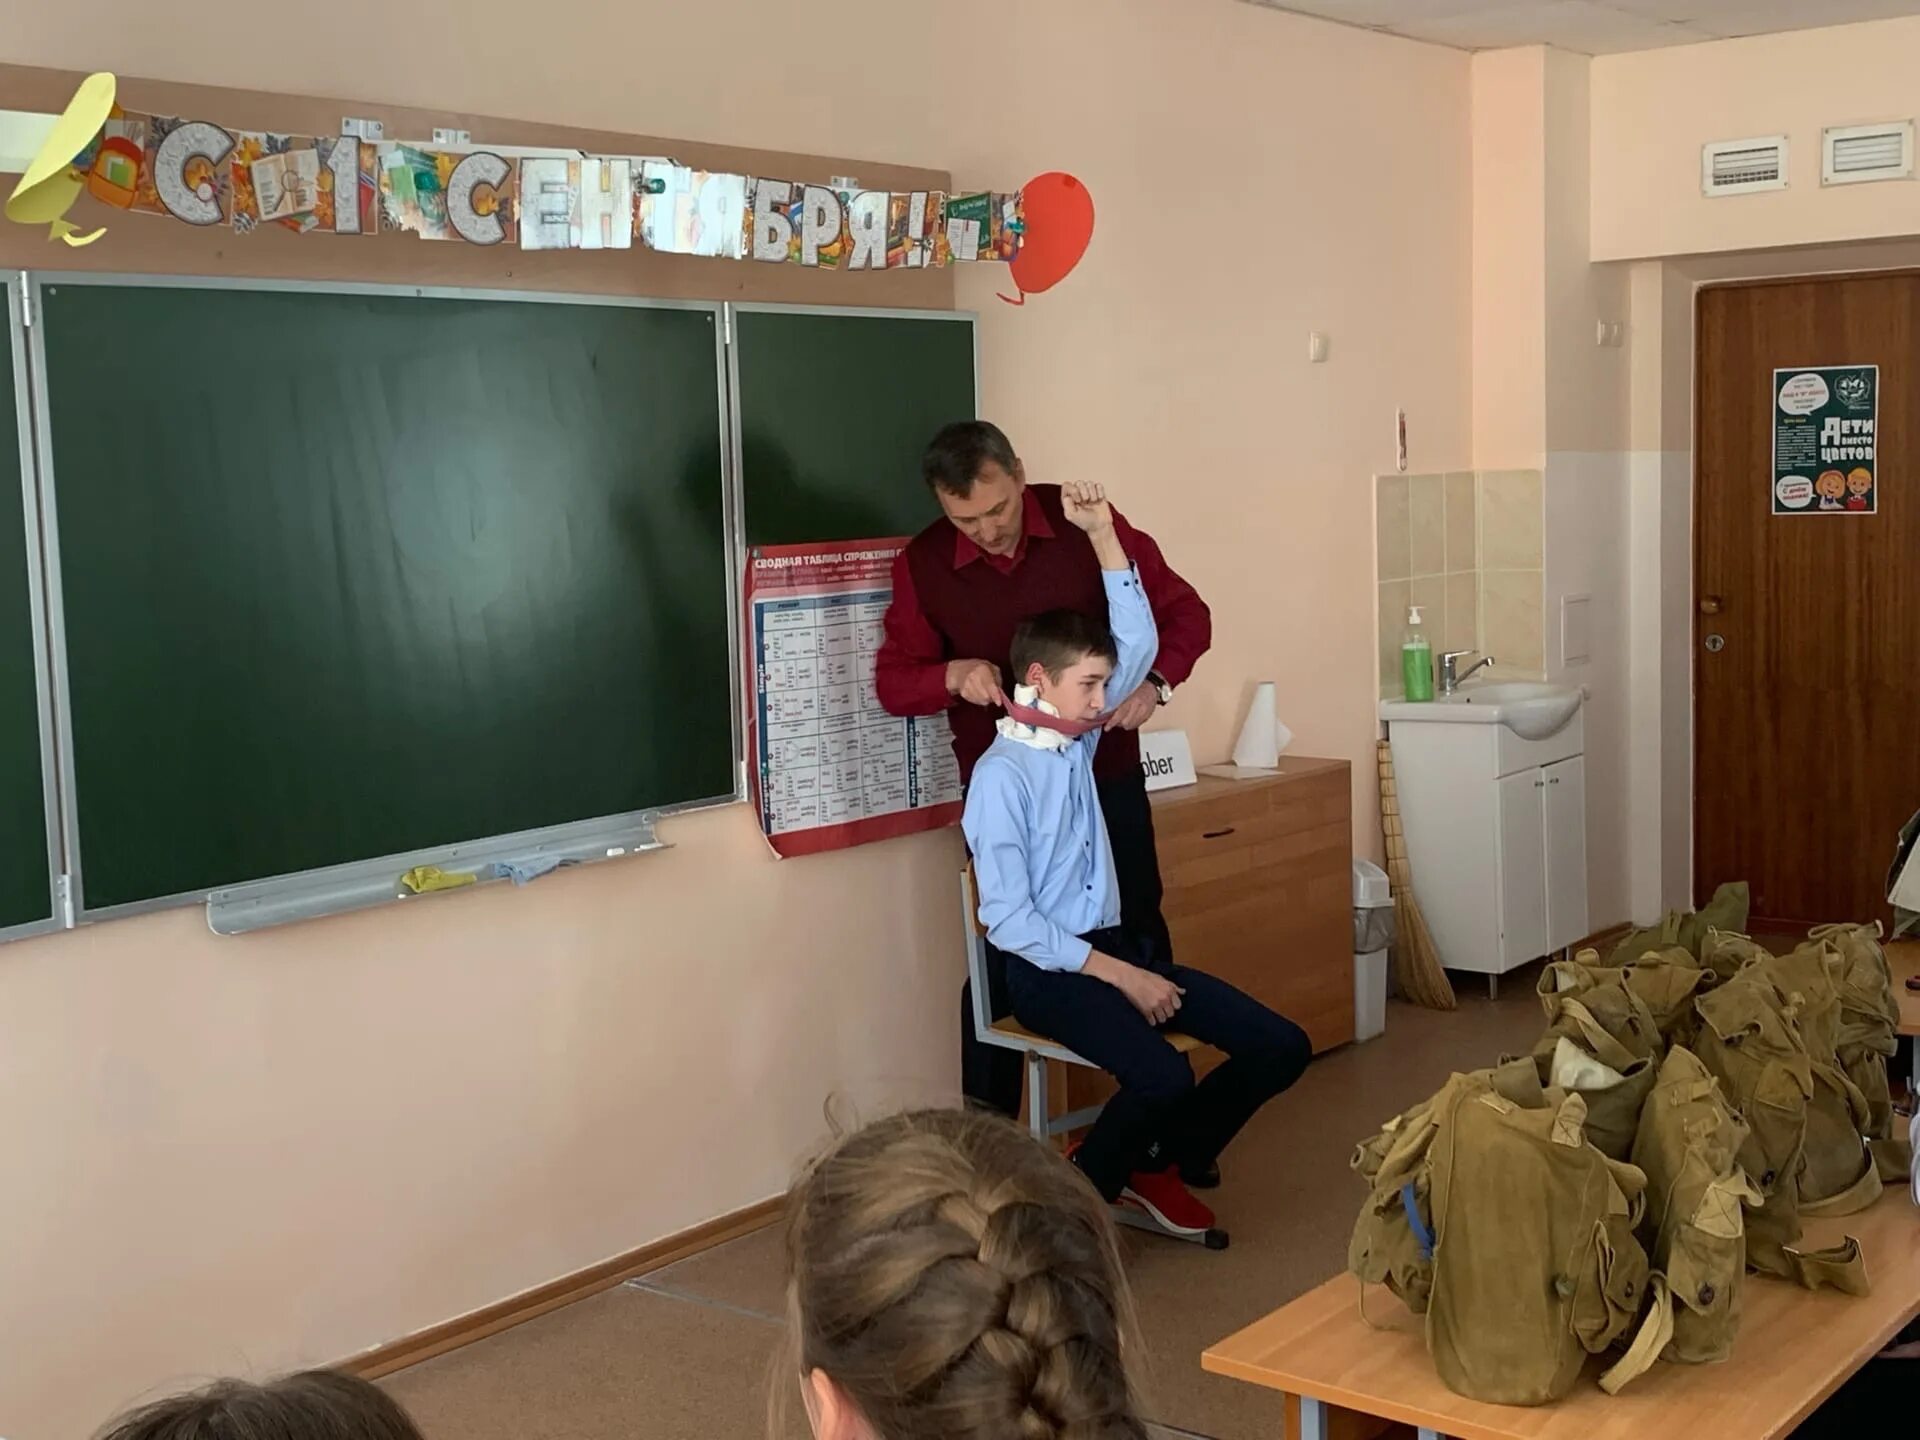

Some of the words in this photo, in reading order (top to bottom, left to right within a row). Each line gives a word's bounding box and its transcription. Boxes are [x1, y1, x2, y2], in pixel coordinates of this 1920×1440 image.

[327, 134, 362, 235] 1
[754, 556, 801, 569] СВОДНАЯ
[803, 553, 843, 566] ТАБЛИЦА
[1140, 751, 1173, 778] ober
